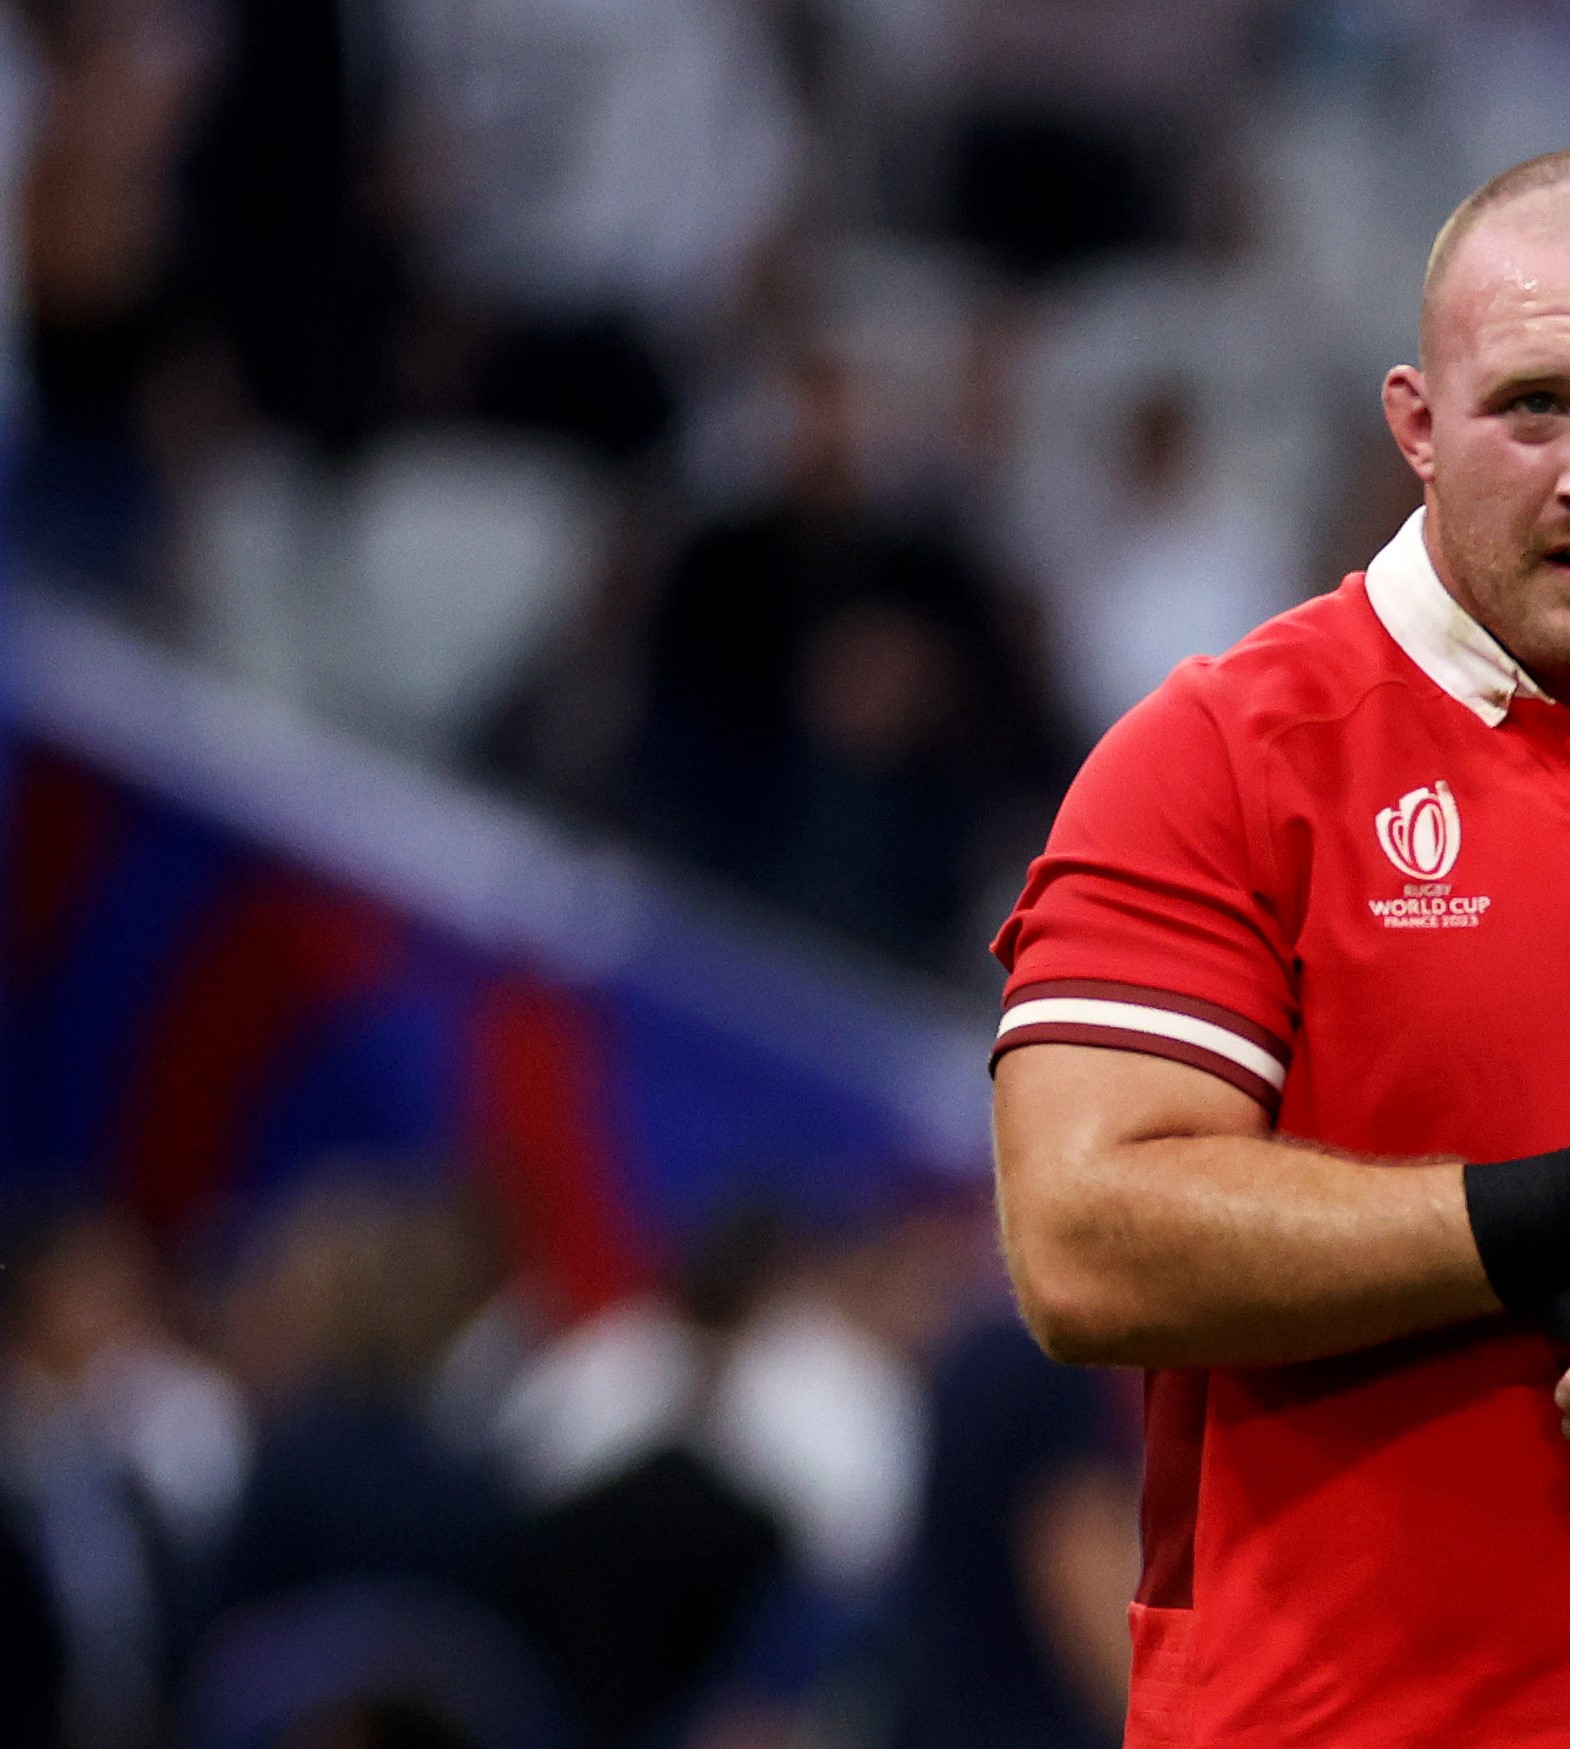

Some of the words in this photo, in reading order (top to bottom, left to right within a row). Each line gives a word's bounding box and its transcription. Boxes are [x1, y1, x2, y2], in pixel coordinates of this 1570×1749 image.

[1368, 898, 1446, 916] WORLD
[1449, 897, 1491, 914] CUP
[1383, 915, 1439, 928] FRANCE
